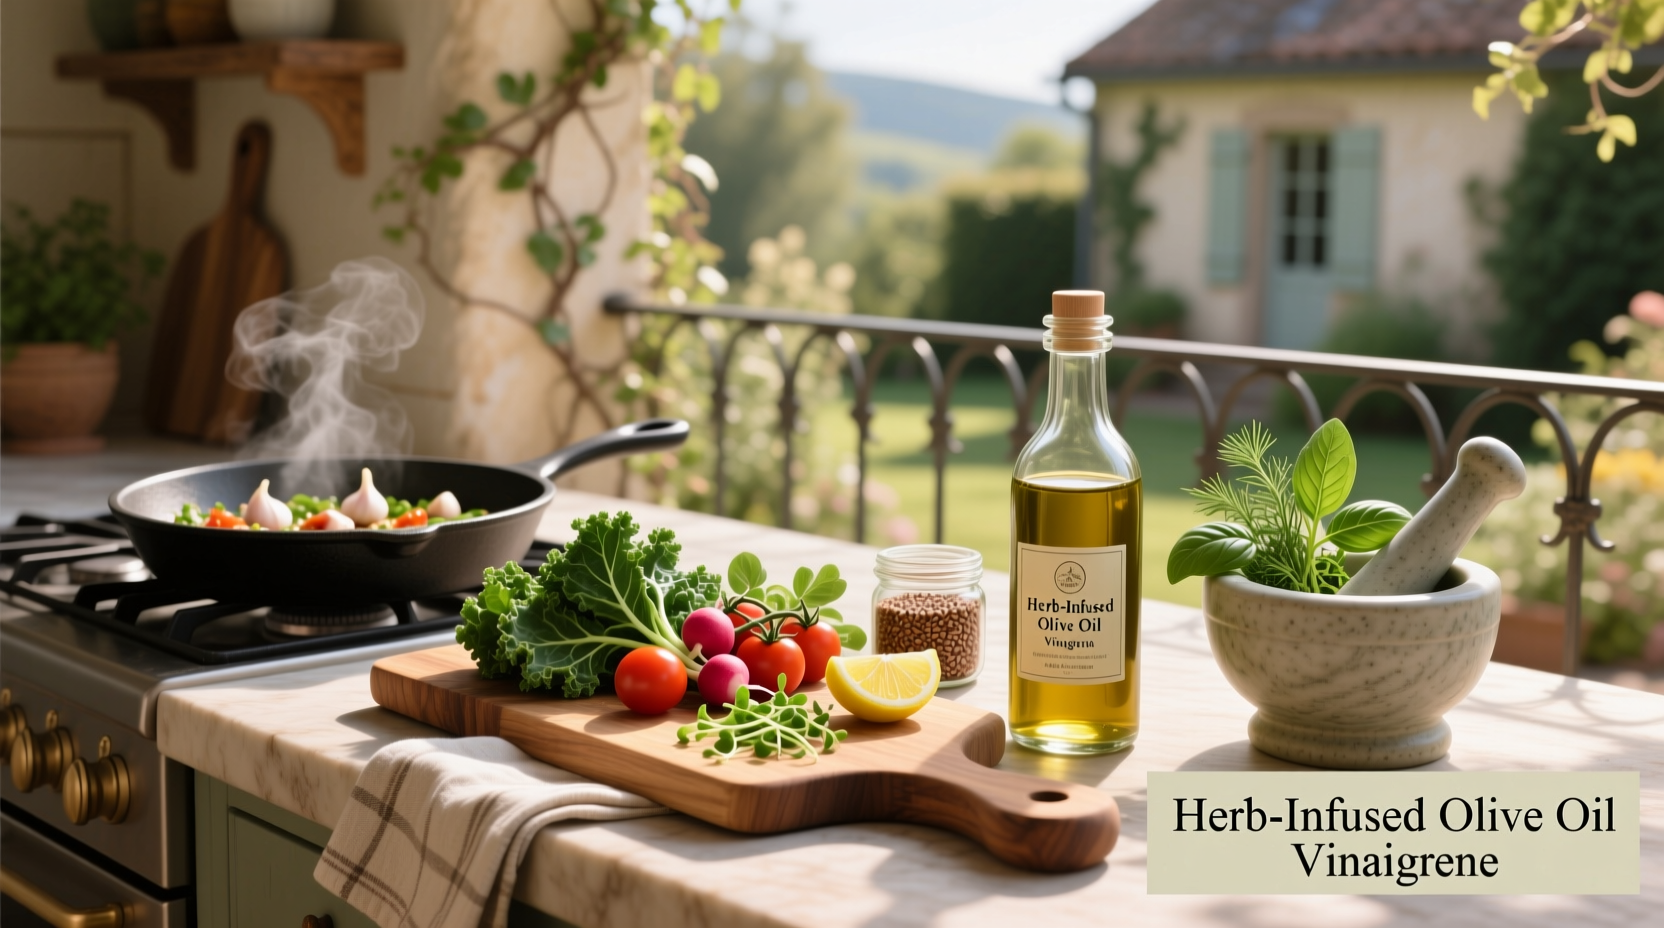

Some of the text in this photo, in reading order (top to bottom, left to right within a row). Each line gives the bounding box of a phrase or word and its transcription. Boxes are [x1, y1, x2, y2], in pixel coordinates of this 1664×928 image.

[1027, 597, 1114, 614] Herb-Infused
[1038, 616, 1101, 632] Olive Oil
